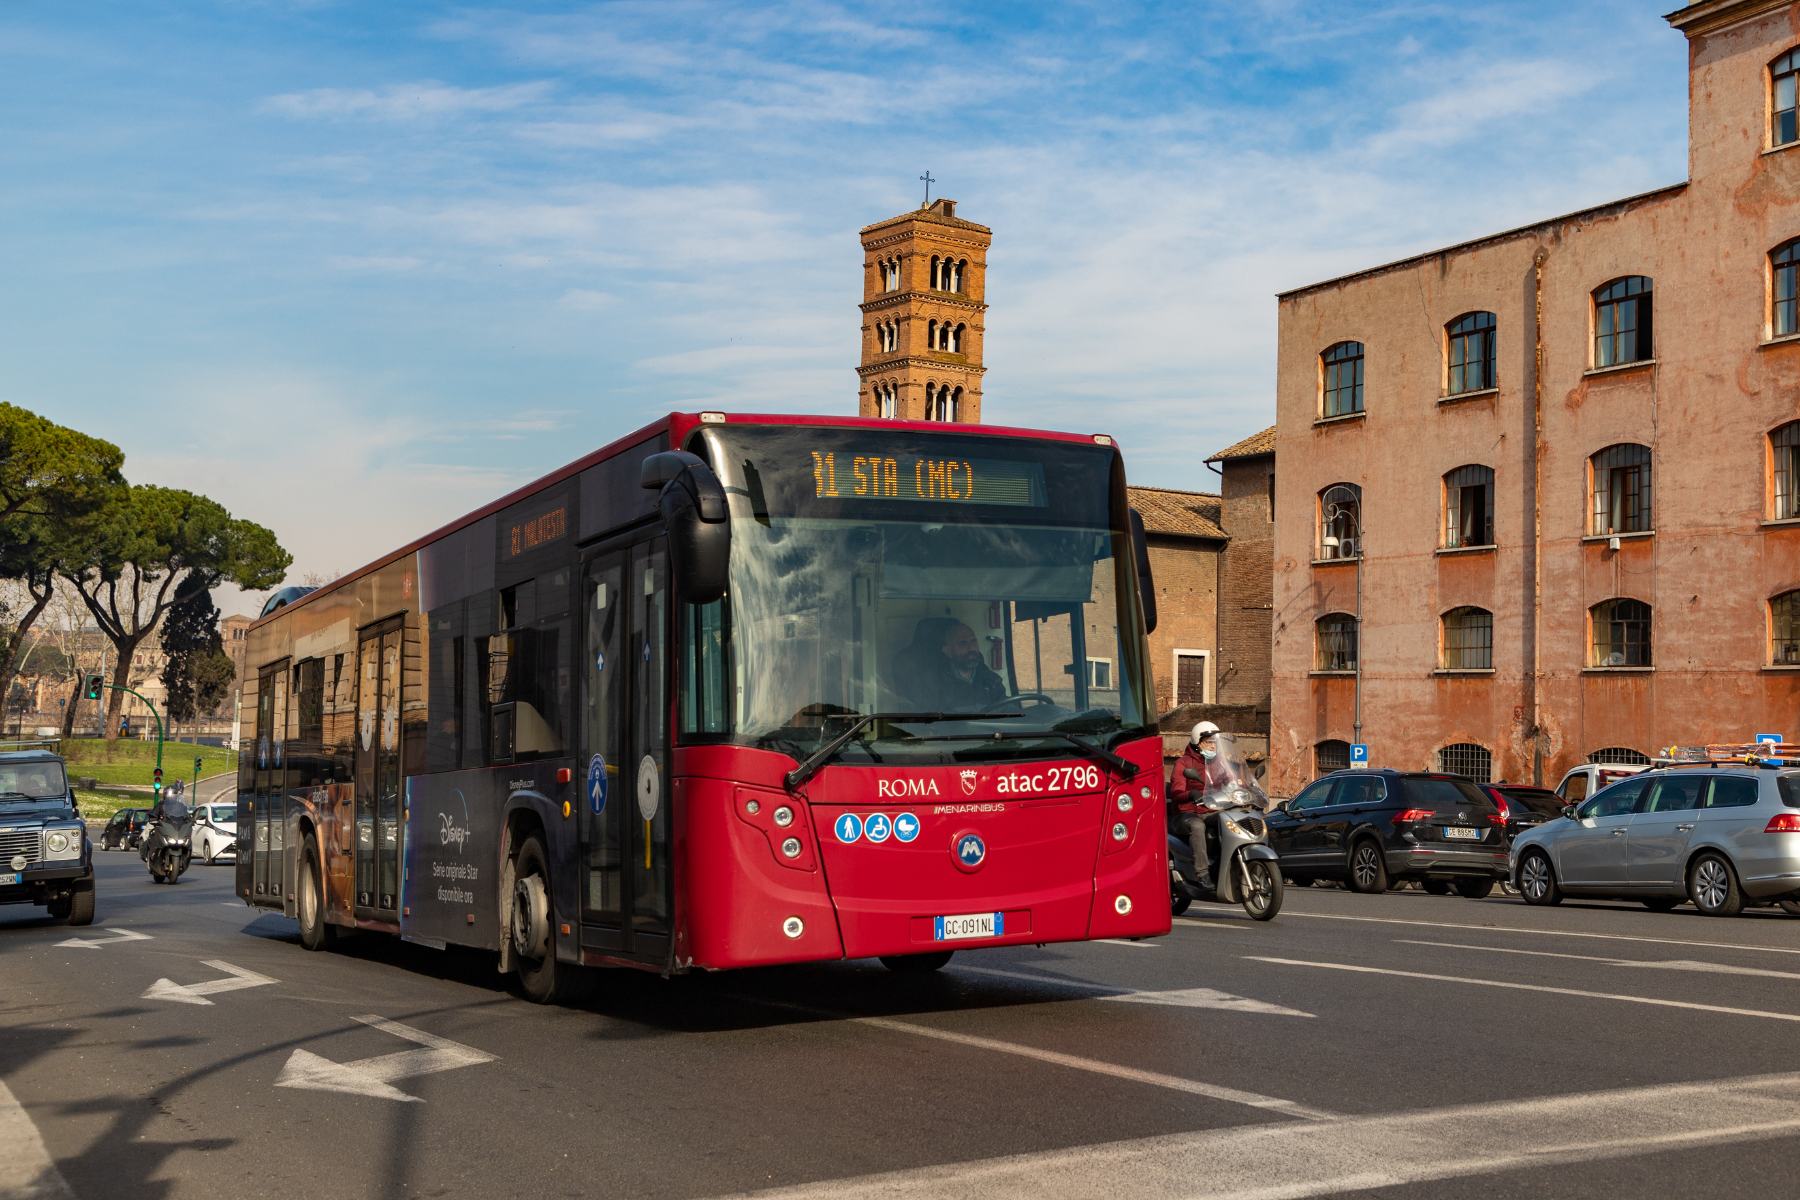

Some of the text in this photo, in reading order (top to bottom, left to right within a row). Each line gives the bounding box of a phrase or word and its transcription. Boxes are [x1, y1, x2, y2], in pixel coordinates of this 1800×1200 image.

[853, 456, 898, 496] STA
[915, 458, 973, 499] (MC)
[1354, 747, 1364, 759] P
[878, 778, 940, 798] ROMA
[997, 773, 1043, 793] atac
[1047, 765, 1099, 791] 2796
[433, 861, 479, 881] Serie originale Star
[464, 892, 473, 904] ora
